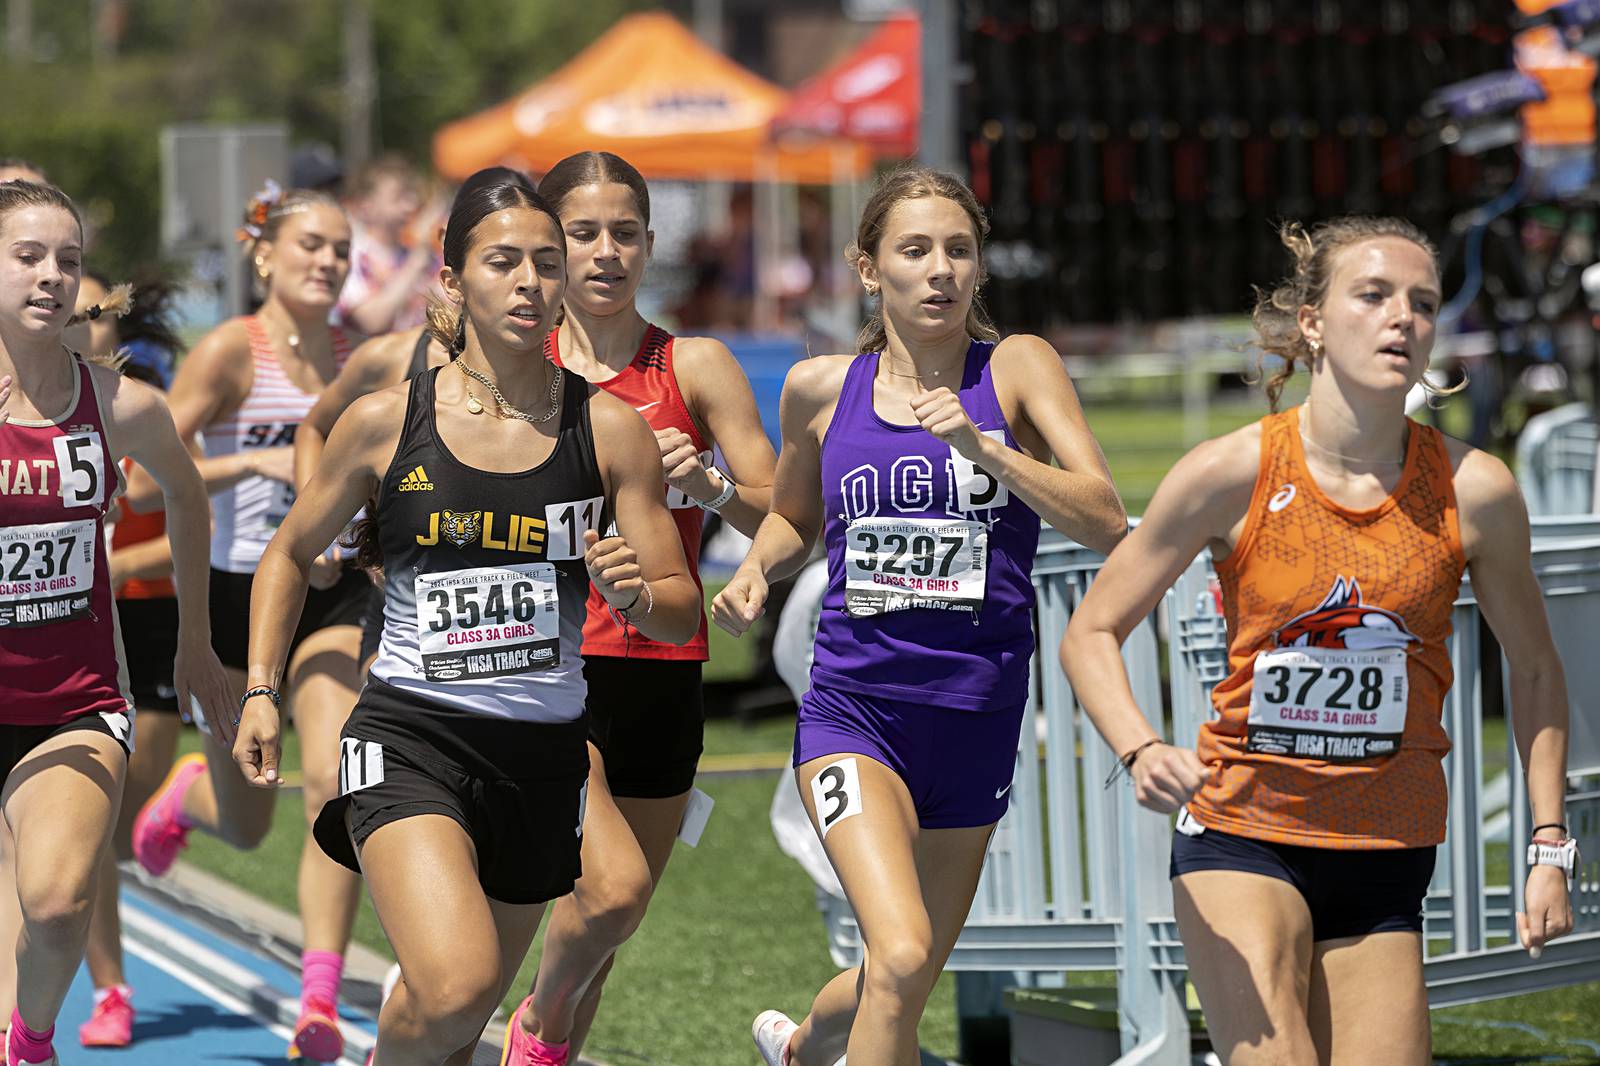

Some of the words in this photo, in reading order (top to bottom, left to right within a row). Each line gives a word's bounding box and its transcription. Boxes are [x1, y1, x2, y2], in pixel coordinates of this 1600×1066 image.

[66, 437, 98, 501] 5
[398, 481, 434, 492] adidas
[559, 501, 595, 557] 11
[860, 524, 875, 532] 2024
[892, 525, 909, 533] STATE
[911, 526, 930, 534] TRACK
[938, 527, 954, 535] FIELD
[0, 535, 76, 582] 237
[855, 532, 964, 577] 3297
[0, 583, 32, 596] CLASS
[34, 580, 48, 593] 3A
[50, 575, 77, 591] GIRLS
[446, 579, 461, 587] IHSA
[461, 577, 479, 585] STATE
[480, 575, 499, 583] TRACK
[506, 572, 523, 580] FIELD
[873, 573, 906, 587] CLASS
[908, 577, 923, 590] 3A
[926, 579, 960, 592] GIRLS
[16, 603, 41, 623] IHSA
[41, 599, 71, 620] TRACK
[427, 581, 536, 633] 3546
[447, 629, 483, 646] CLASS
[486, 627, 501, 641] 3A
[503, 623, 535, 639] GIRLS
[466, 653, 494, 674] IHSA
[494, 648, 530, 671] TRACK
[1264, 666, 1383, 711] 3728
[1280, 707, 1319, 722] CLASS
[1322, 711, 1339, 724] 3A
[1342, 712, 1378, 726] GIRLS
[1295, 734, 1326, 756] IHSA
[1326, 736, 1367, 757] TRACK
[819, 765, 849, 826] 3
